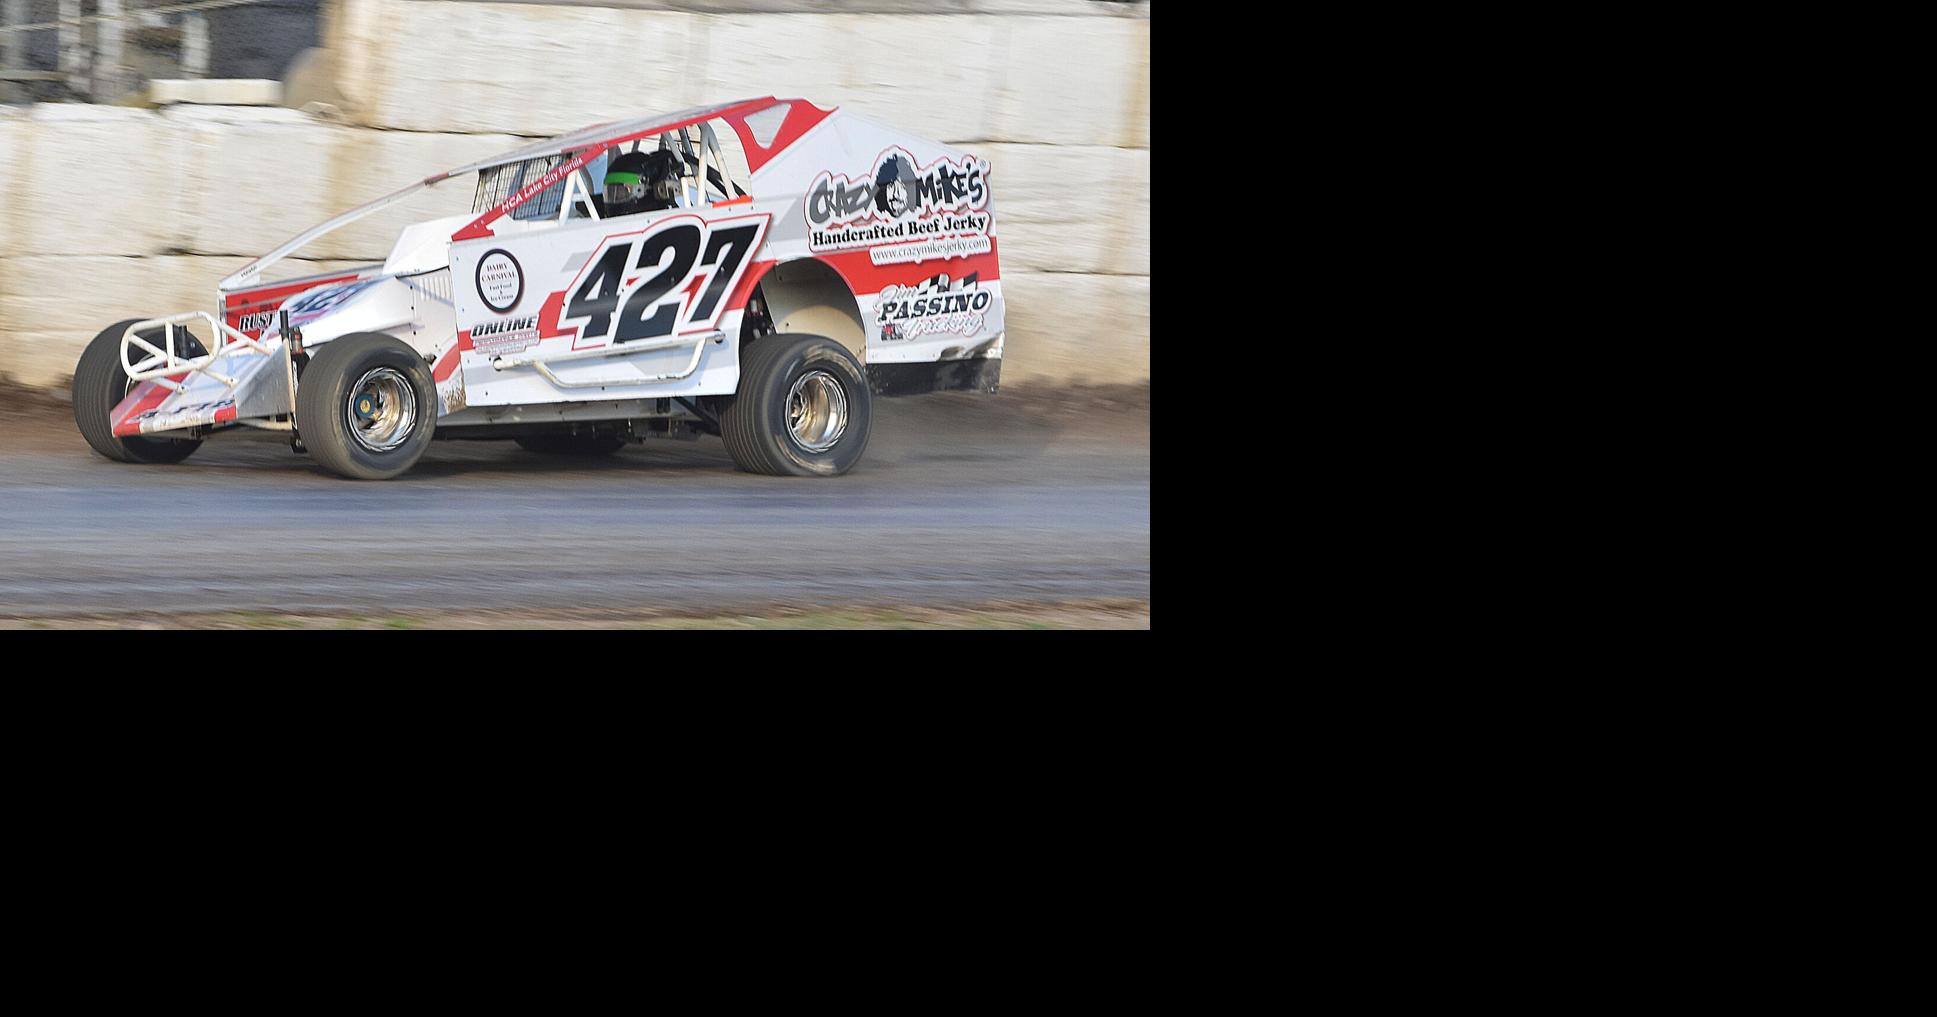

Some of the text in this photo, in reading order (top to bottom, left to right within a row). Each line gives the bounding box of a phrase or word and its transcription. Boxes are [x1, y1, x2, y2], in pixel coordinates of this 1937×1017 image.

[501, 157, 583, 213] HCA Lake City Florida
[810, 178, 879, 224] CRAZY
[813, 215, 987, 246] Handcrafted Beef Jerky
[873, 239, 989, 262] www.crazymikesjerky.com
[481, 271, 516, 282] CARNIVAL
[486, 263, 508, 272] DAIRY
[566, 224, 760, 343] 427
[877, 291, 989, 322] PASSINO
[472, 316, 538, 337] ONLINE
